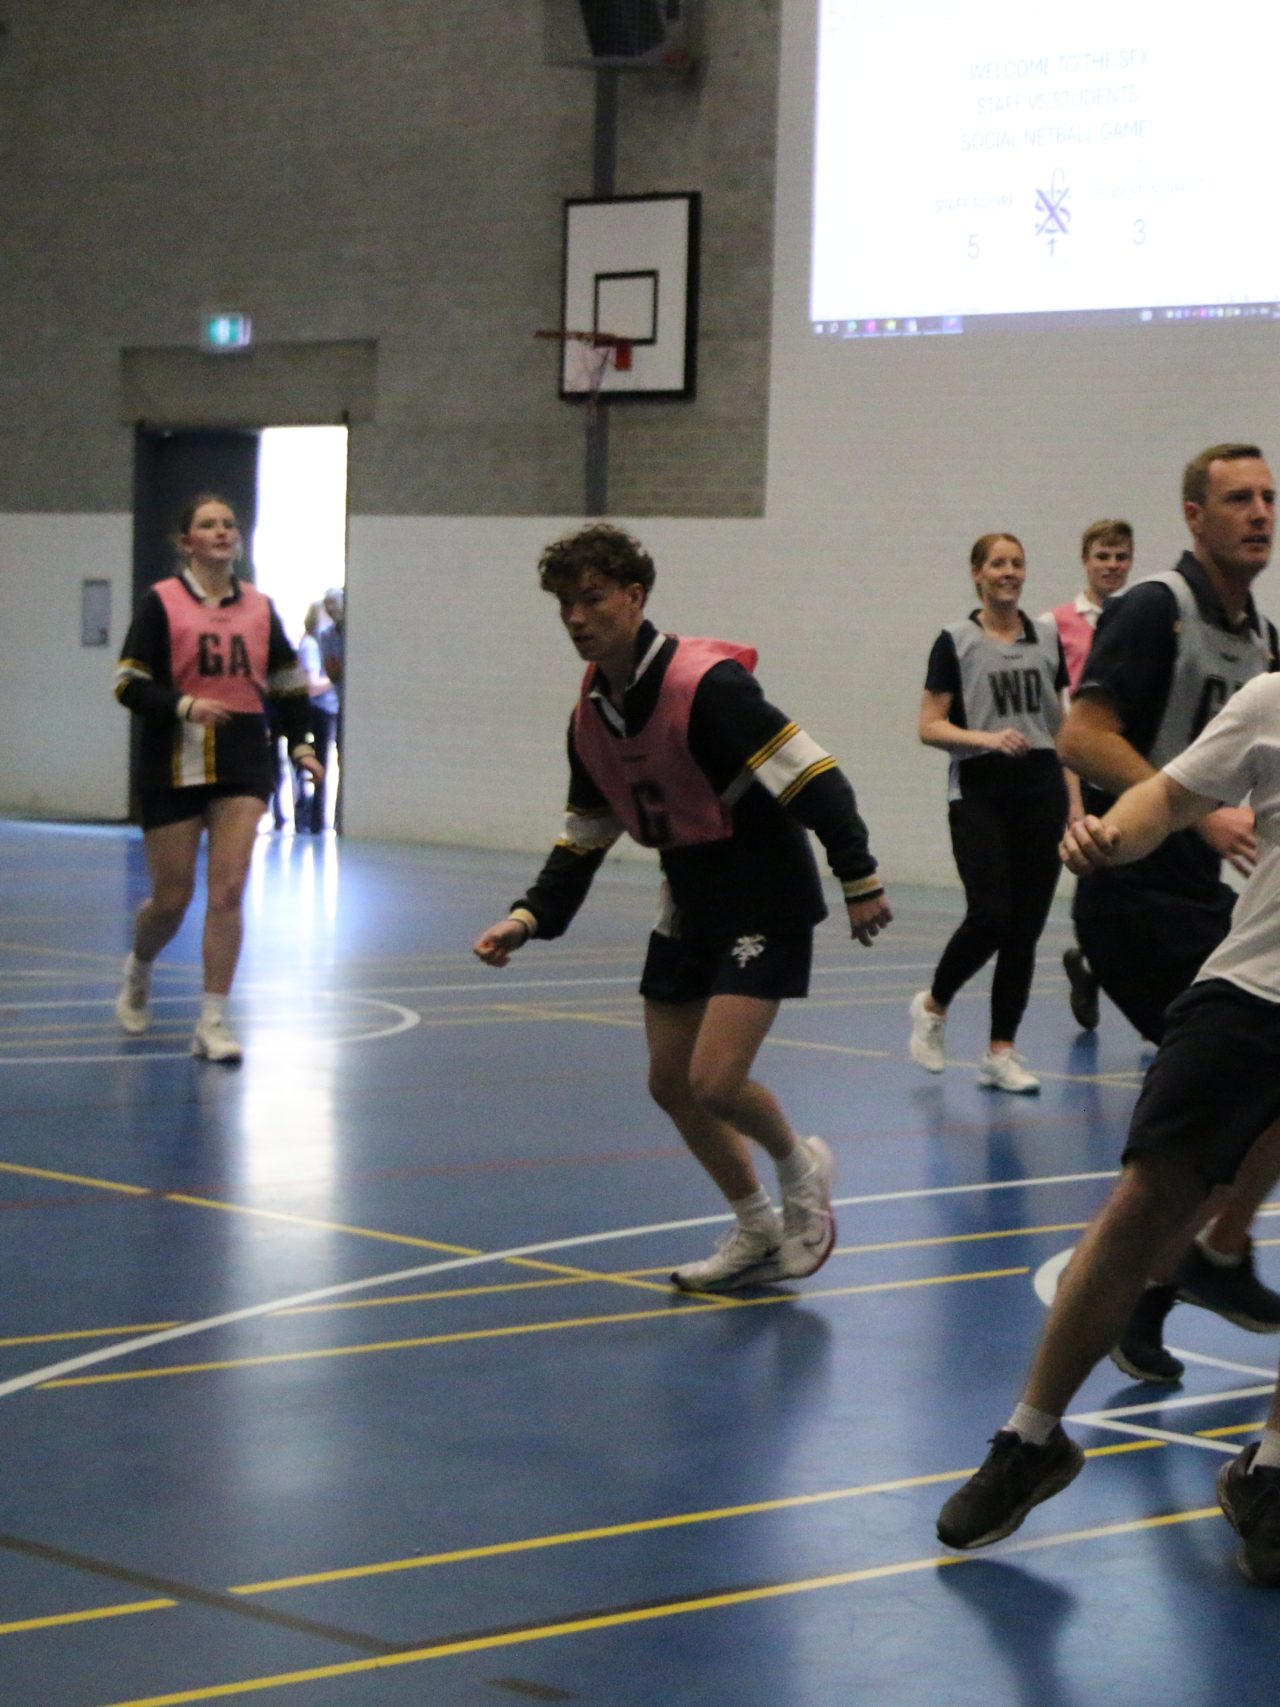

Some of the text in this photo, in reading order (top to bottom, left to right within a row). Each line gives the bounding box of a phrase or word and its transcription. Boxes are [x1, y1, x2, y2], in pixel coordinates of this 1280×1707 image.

[969, 55, 1051, 80] WELCOME
[1056, 54, 1079, 73] TO
[1083, 50, 1112, 70] THE
[977, 84, 1140, 116] STAFF VS STUDENTS
[960, 131, 1020, 152] SOCIAL
[1024, 124, 1095, 147] NETBALL
[967, 233, 981, 260] 5
[1131, 217, 1146, 246] 3
[197, 633, 252, 678] GA
[987, 667, 1042, 718] WD
